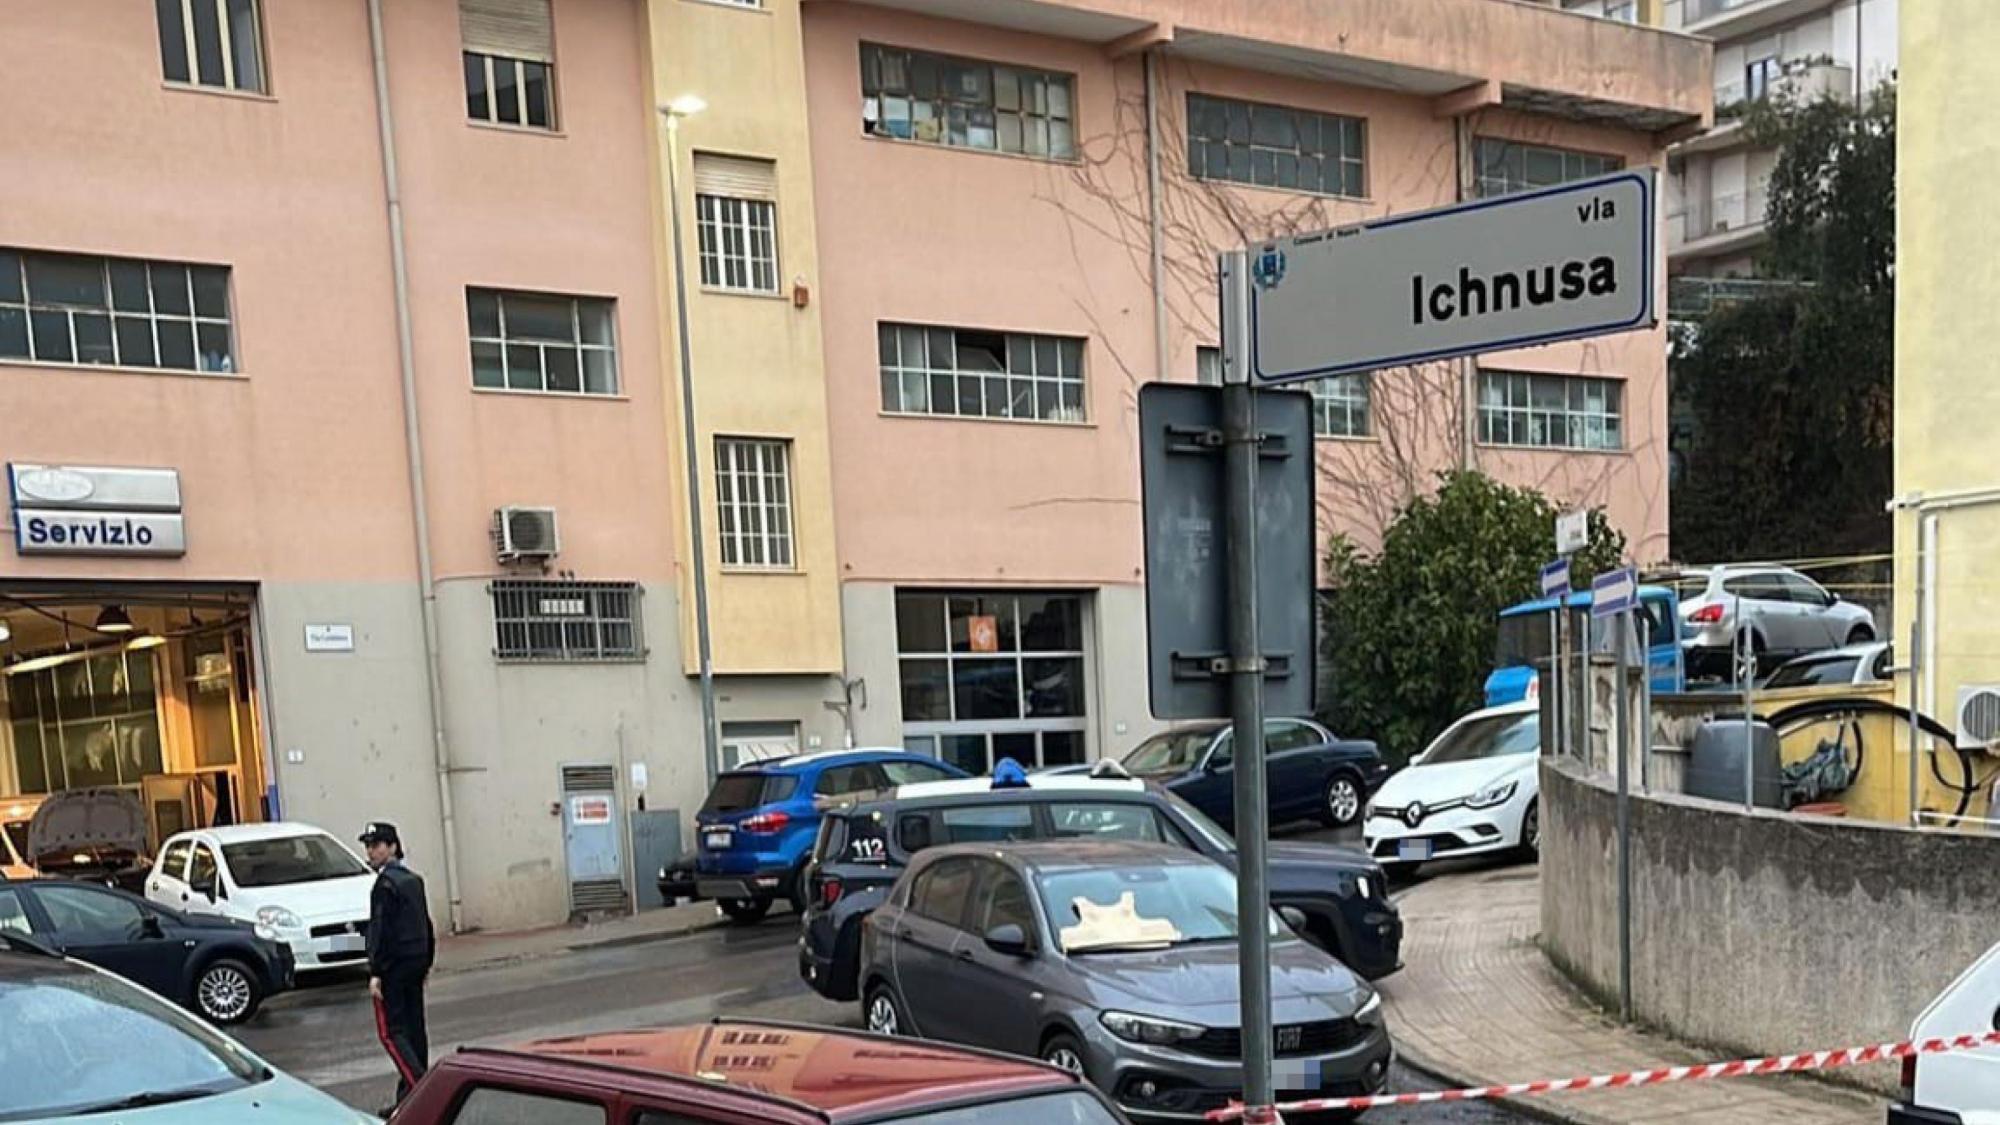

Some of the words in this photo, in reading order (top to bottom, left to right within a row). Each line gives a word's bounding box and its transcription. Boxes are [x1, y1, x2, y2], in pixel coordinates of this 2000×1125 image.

[1578, 197, 1615, 222] via
[1413, 256, 1617, 325] Ichnusa
[28, 518, 153, 546] Servizio
[851, 838, 886, 858] 112
